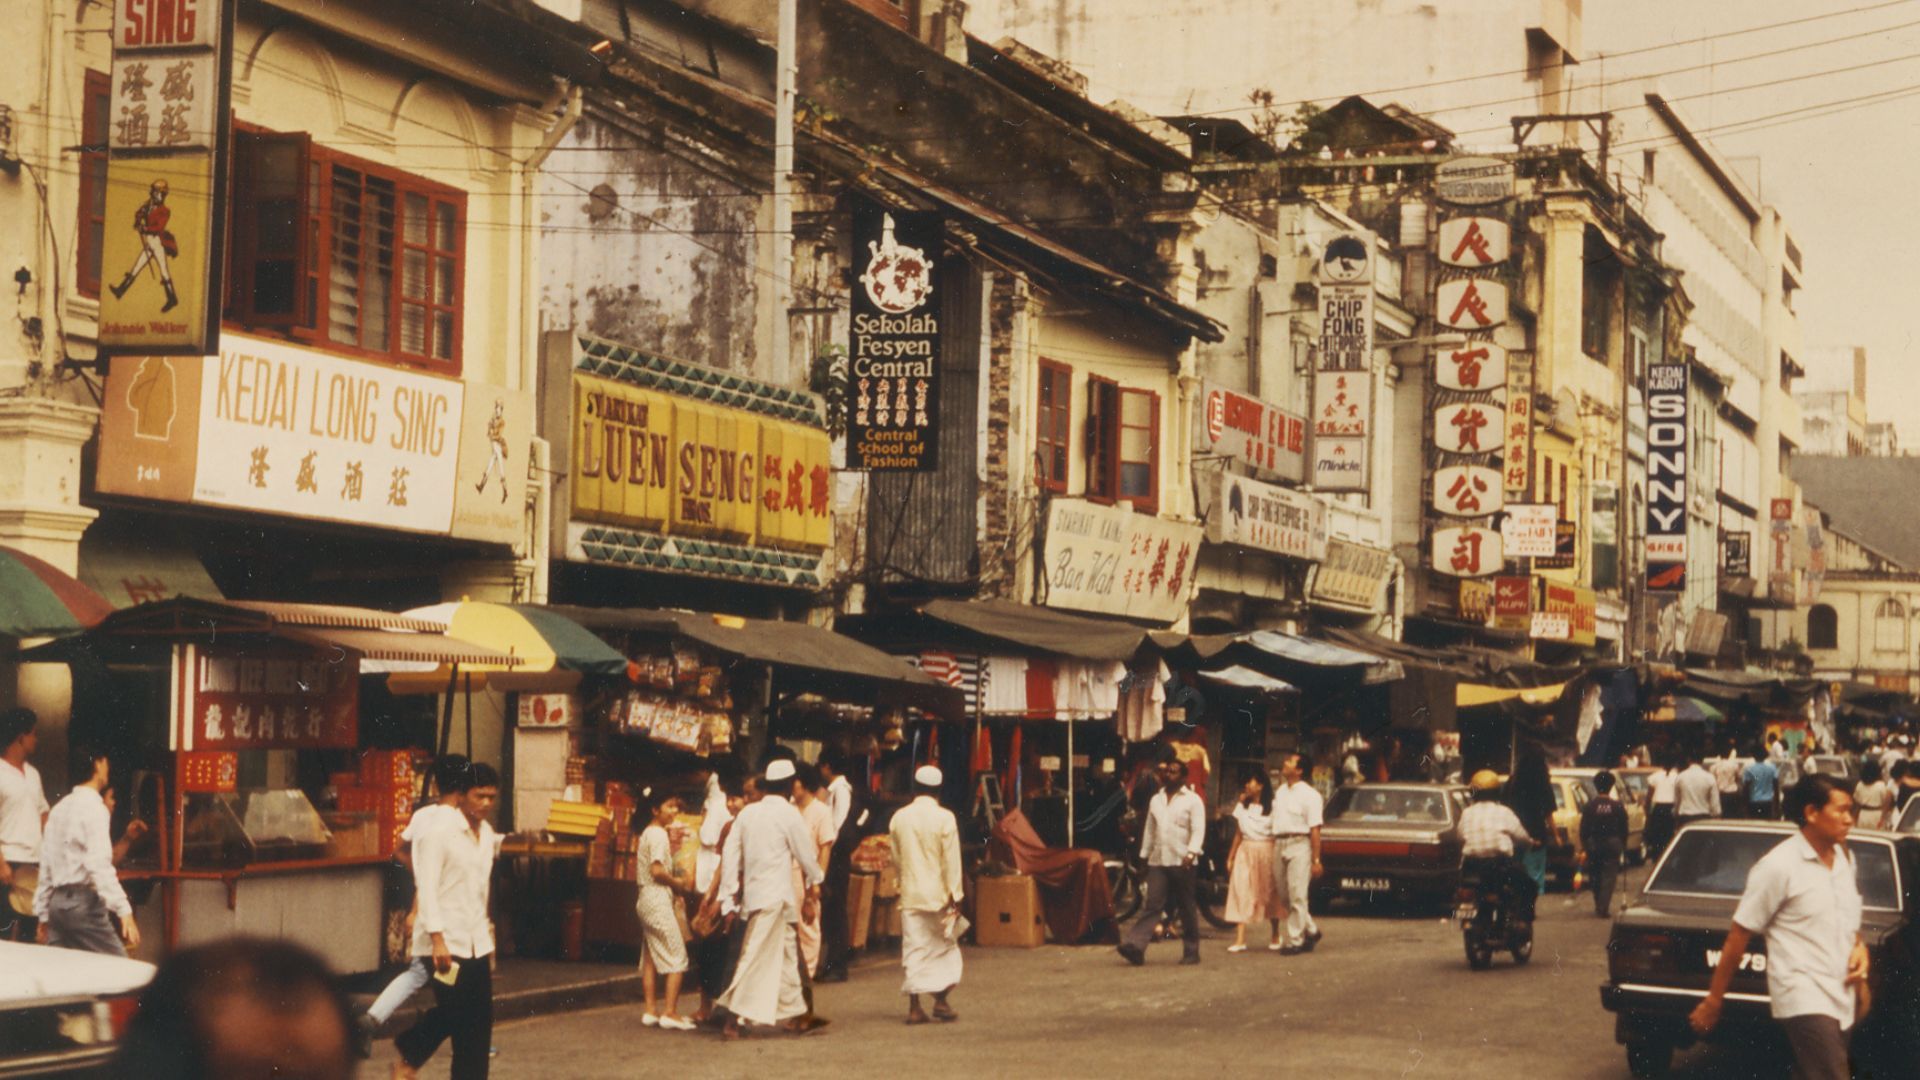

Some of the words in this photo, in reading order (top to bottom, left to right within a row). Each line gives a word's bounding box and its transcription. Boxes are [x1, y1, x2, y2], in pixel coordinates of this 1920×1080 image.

[125, 0, 196, 45] SING
[1326, 300, 1362, 318] CHIP
[853, 313, 938, 334] Sekolah
[1322, 318, 1364, 335] FONG
[857, 335, 931, 358] Fesyen
[854, 357, 934, 377] Central
[1651, 366, 1684, 379] KEDAI
[1649, 378, 1685, 390] KASUT
[216, 351, 301, 432] KEDAI
[308, 367, 380, 445] LONG
[390, 384, 449, 457] SING
[865, 428, 918, 441] Central
[857, 441, 904, 454] School
[908, 442, 924, 455] of
[582, 421, 668, 489] LUEN
[679, 442, 754, 504] SENG
[863, 455, 918, 467] Fashion
[1648, 395, 1686, 532] SONNY
[1048, 546, 1085, 592] Ban
[1738, 952, 1767, 972] 79
